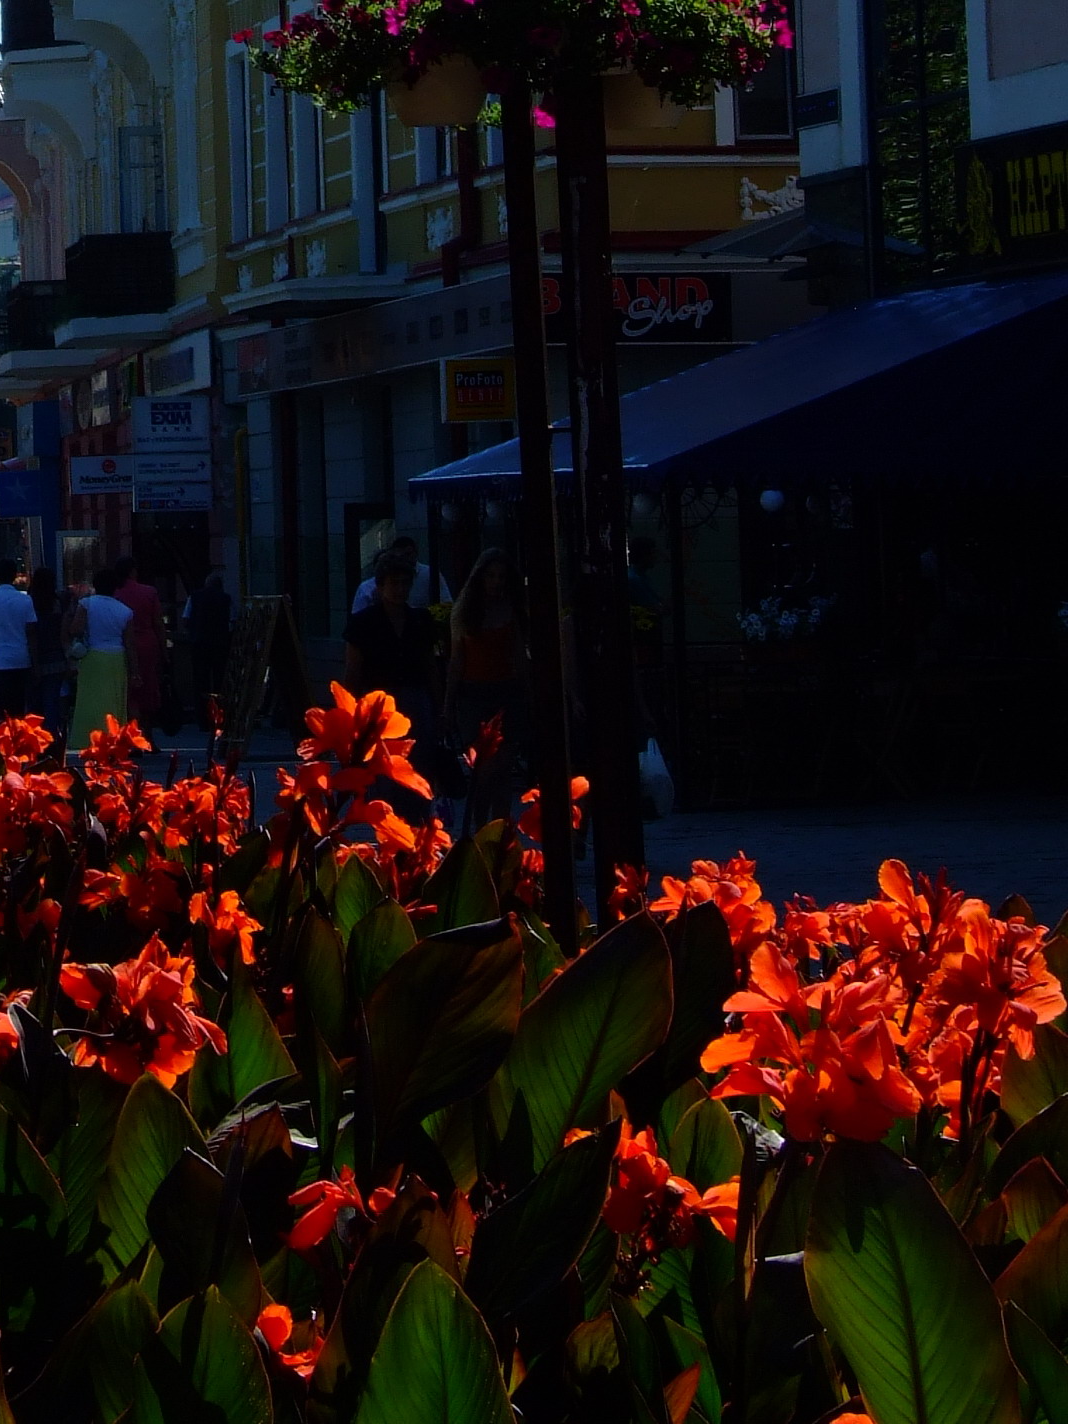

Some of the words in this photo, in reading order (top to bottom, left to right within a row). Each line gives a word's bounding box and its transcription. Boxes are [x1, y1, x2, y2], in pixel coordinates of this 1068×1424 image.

[1005, 150, 1068, 237] НАРТ
[541, 277, 709, 318] BAND
[622, 296, 714, 337] Shop
[456, 372, 503, 387] ProFoto
[151, 412, 191, 425] EXIM
